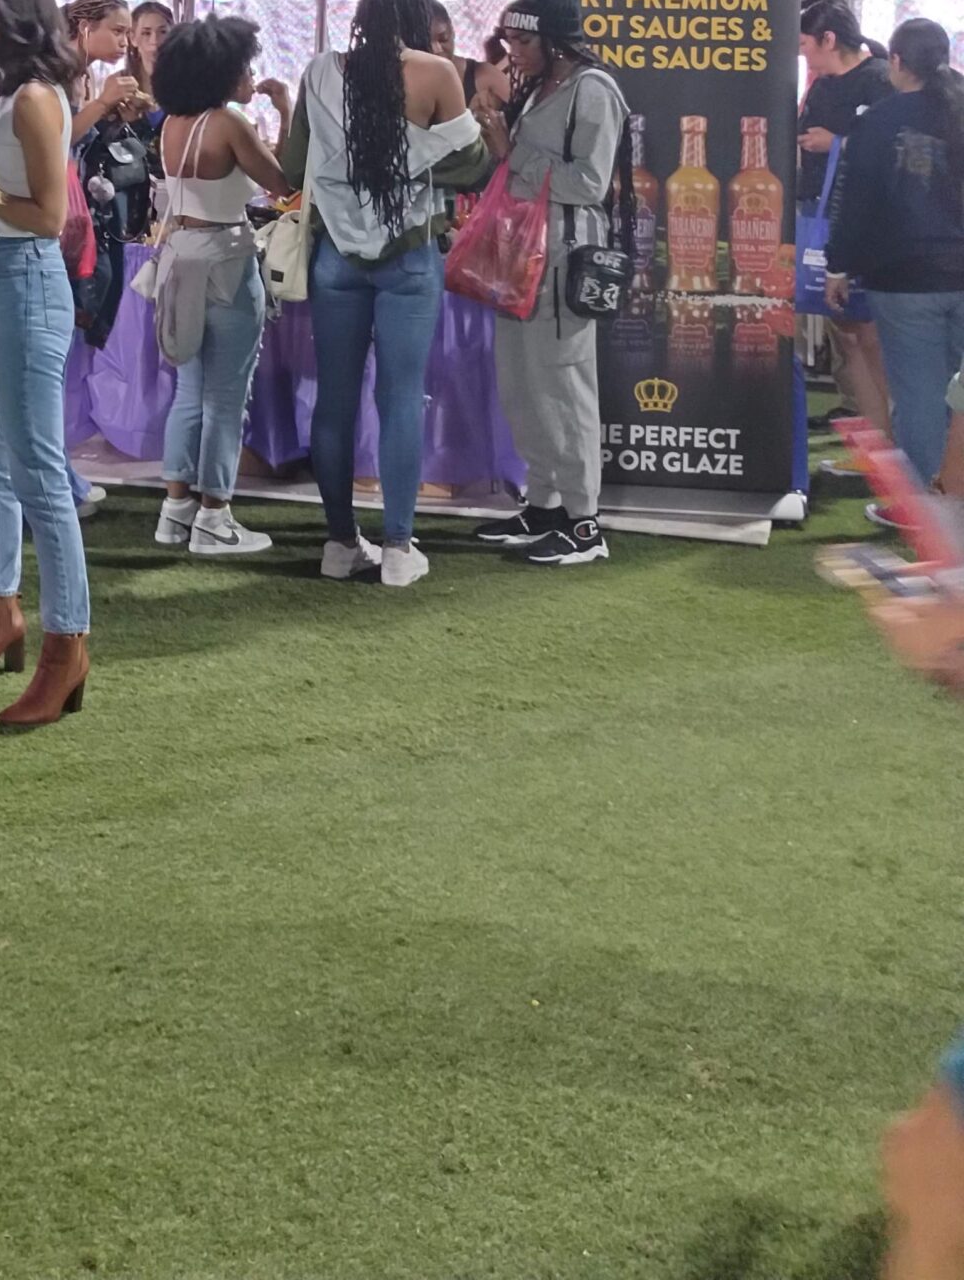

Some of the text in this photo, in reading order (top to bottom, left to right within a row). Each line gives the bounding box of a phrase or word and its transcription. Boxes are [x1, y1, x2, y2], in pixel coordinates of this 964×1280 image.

[583, 14, 773, 41] OT SAUCES &
[588, 44, 768, 71] ING SAUCES
[630, 424, 741, 450] PERFECT
[618, 449, 657, 471] OR
[662, 452, 744, 475] GLAZE
